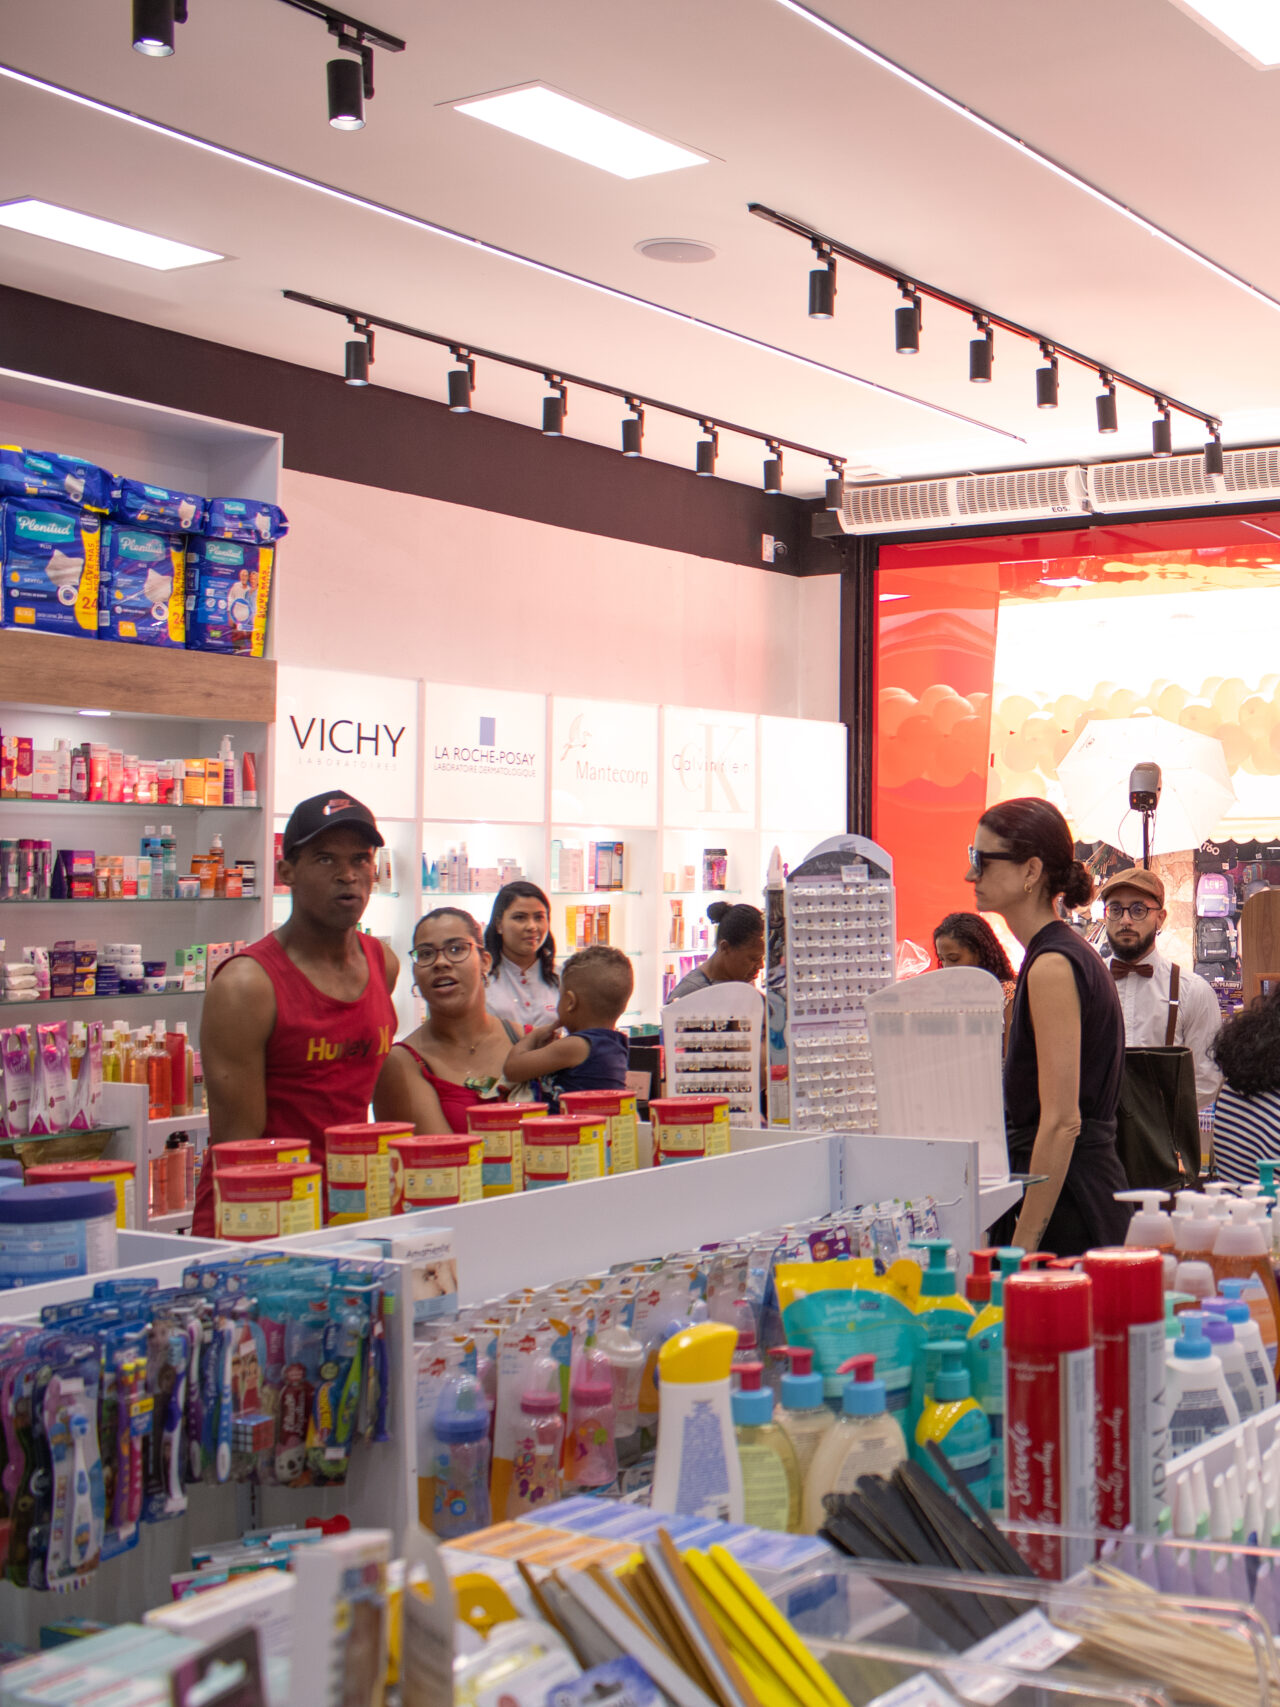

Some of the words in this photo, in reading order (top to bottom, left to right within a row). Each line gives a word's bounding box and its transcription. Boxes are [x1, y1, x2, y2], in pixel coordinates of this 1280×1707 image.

[18, 516, 72, 535] Plenitud
[120, 536, 164, 555] Plenitud
[207, 544, 242, 559] Plenitud
[290, 715, 406, 757] VICHY
[298, 757, 398, 772] LABORATOIRES
[434, 746, 450, 760] LA
[453, 747, 536, 766] ROCHE-POSAY
[433, 762, 477, 774] LABORATOIRE
[575, 760, 649, 787] Mantecorp
[306, 1037, 373, 1061] Hurley
